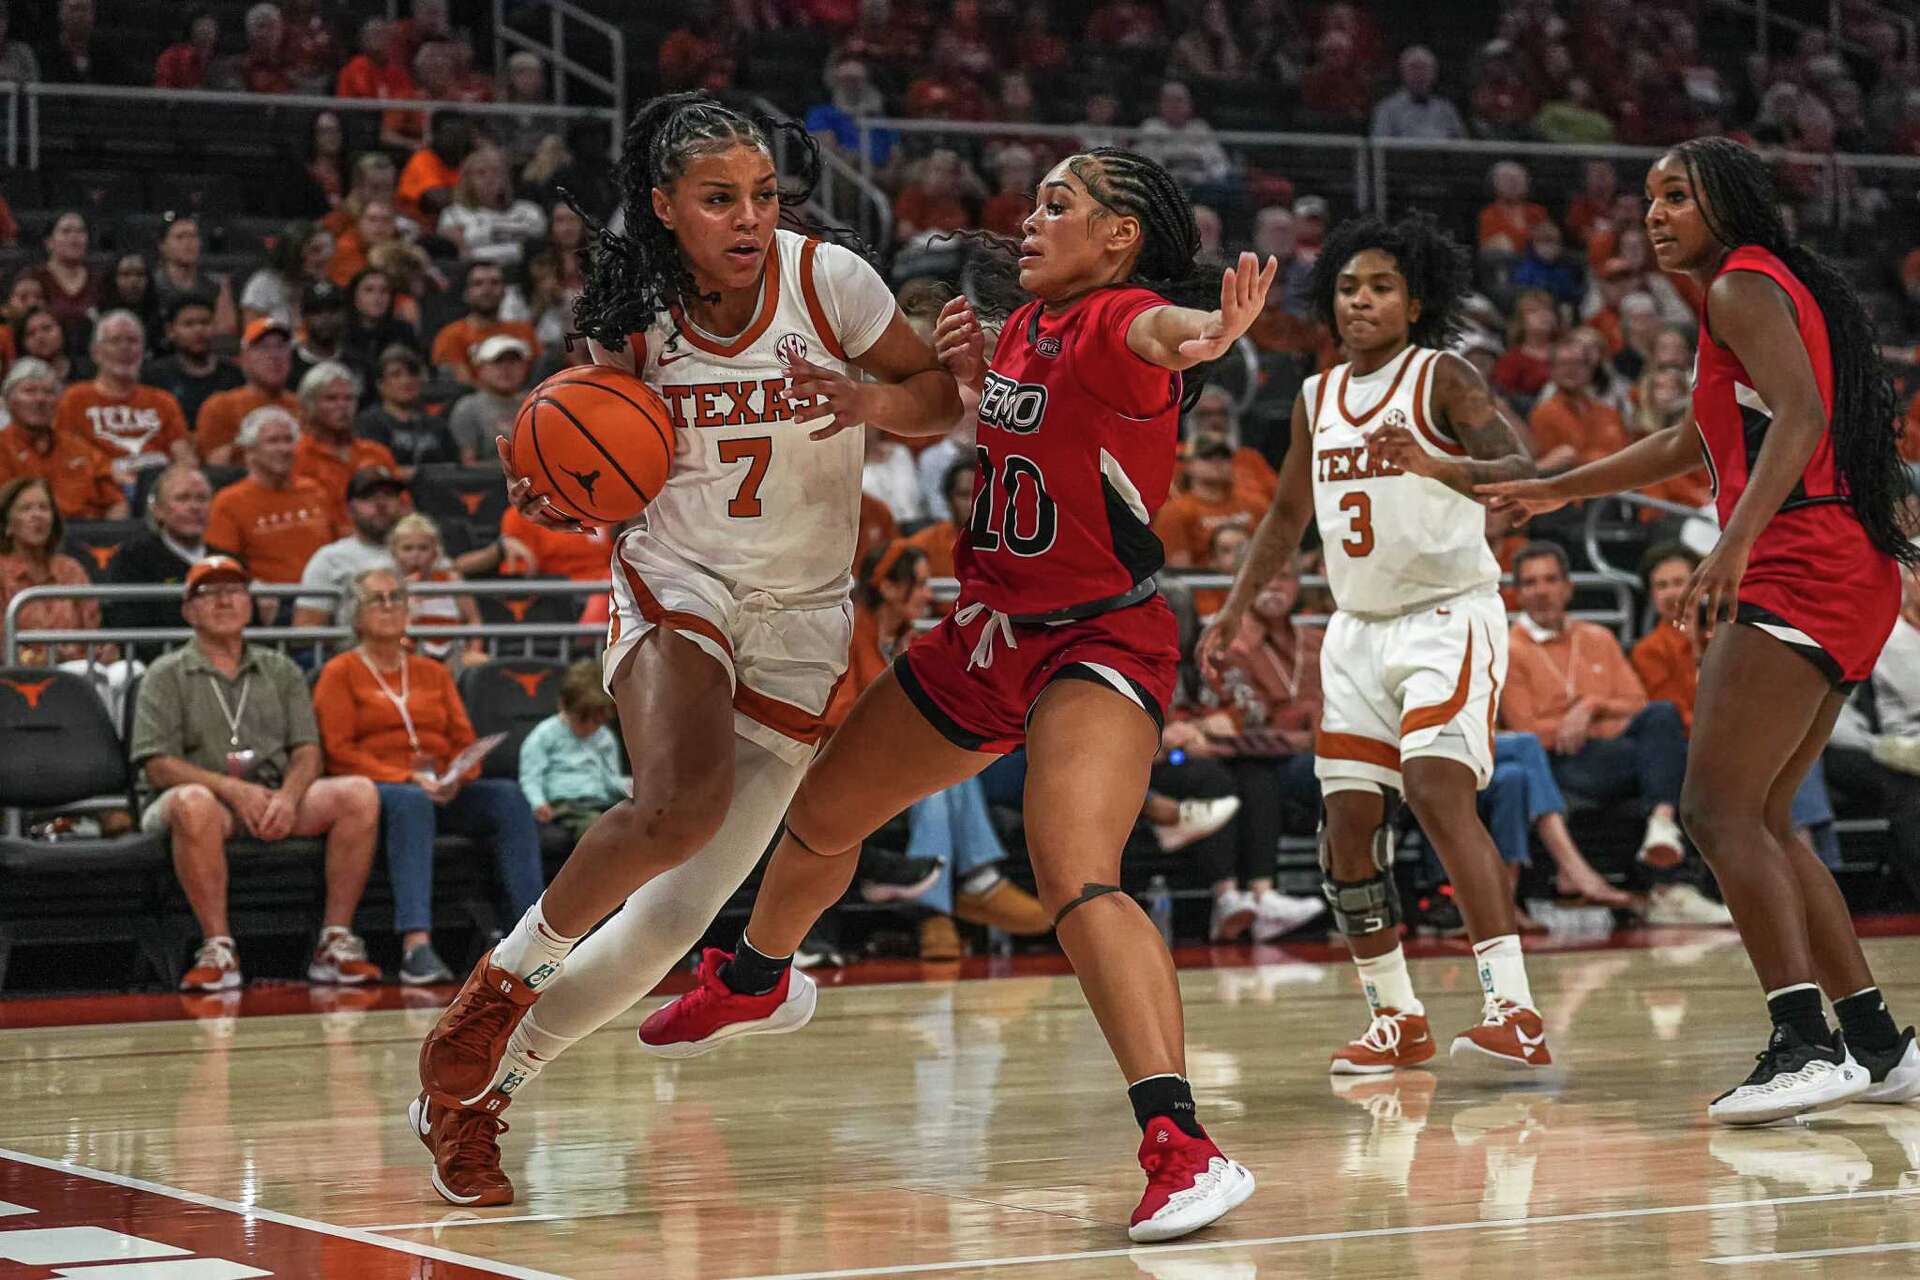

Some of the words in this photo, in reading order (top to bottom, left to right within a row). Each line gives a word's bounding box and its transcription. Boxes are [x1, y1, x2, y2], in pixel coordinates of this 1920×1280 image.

[717, 436, 773, 518] 7
[970, 444, 1058, 557] 10
[1339, 491, 1375, 558] 3
